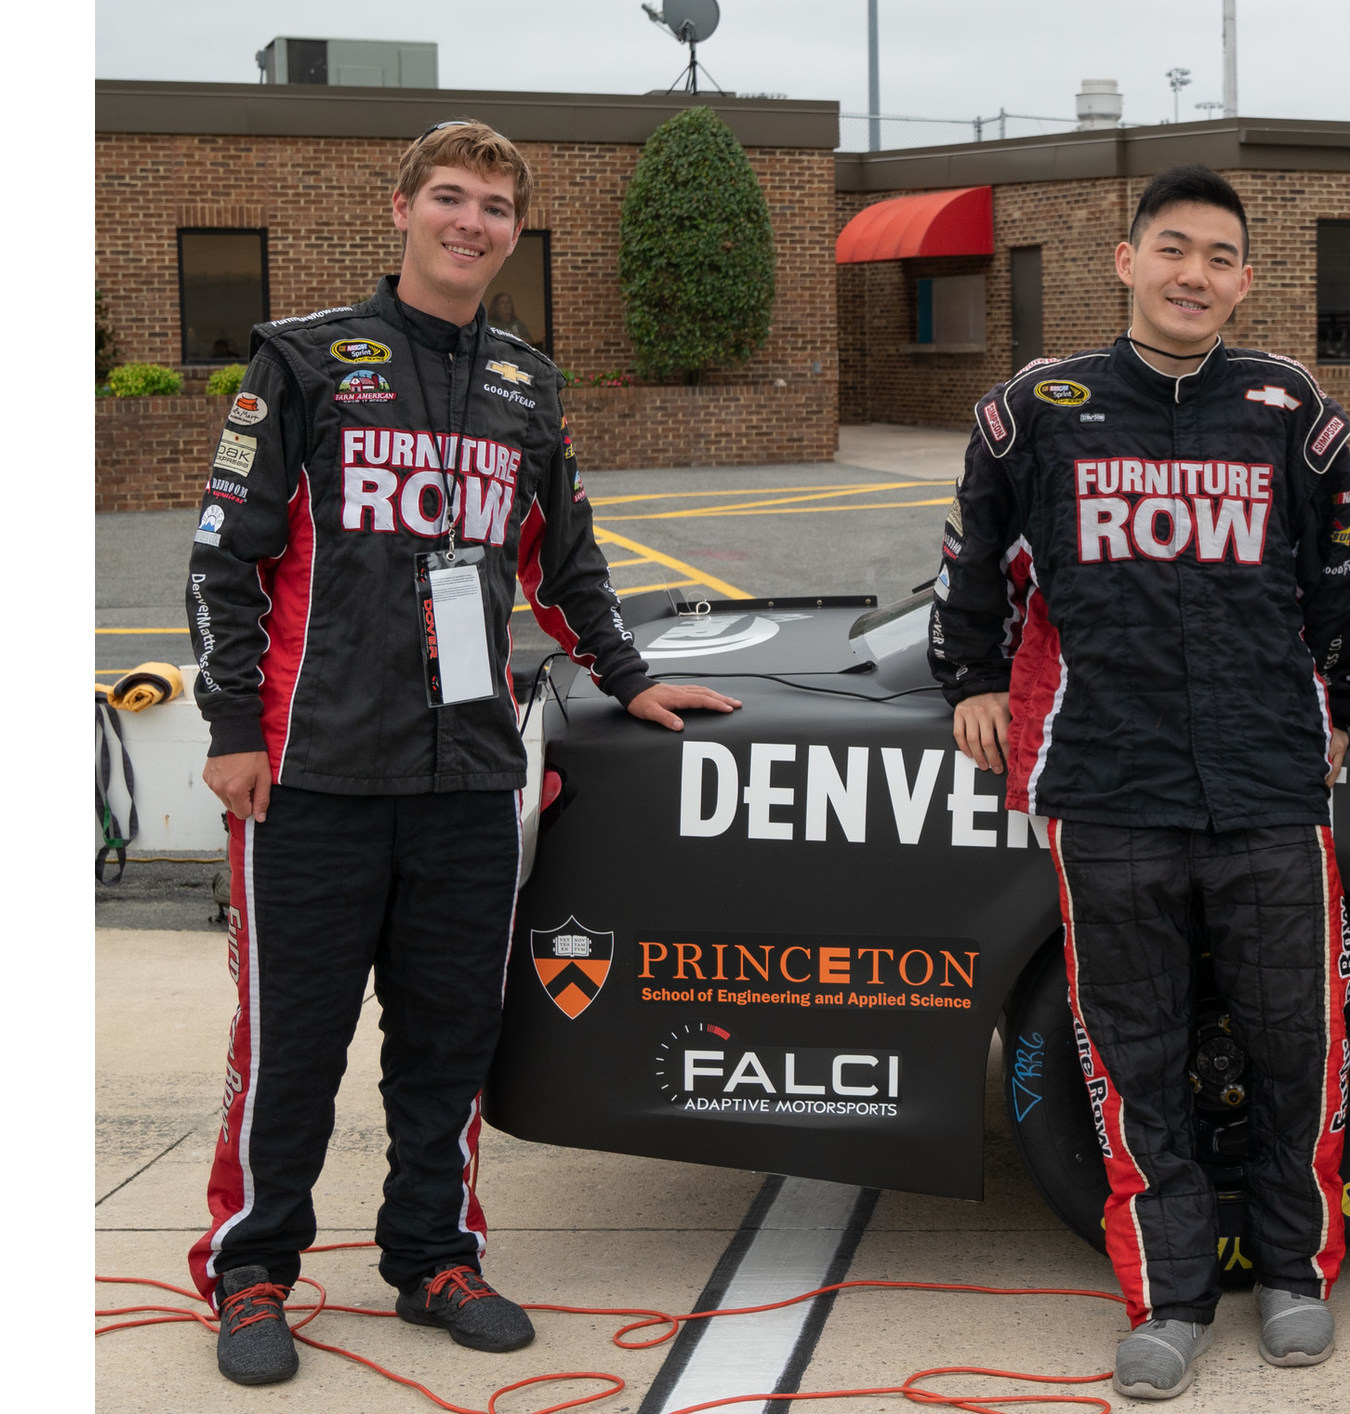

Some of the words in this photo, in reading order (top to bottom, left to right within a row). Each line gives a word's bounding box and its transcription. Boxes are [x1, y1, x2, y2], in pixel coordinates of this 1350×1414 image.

[985, 404, 1004, 438] SIMPSON
[1314, 419, 1342, 453] SIMPSON
[217, 456, 249, 469] XPRESS
[343, 429, 521, 484] FURNITURE
[1077, 460, 1272, 499] FURNITURE
[343, 467, 514, 545] ROW
[1078, 497, 1269, 562] ROW
[424, 599, 438, 660] DOVER
[637, 941, 980, 988] PRINCETON
[641, 987, 694, 1001] School
[697, 988, 713, 1001] of
[717, 989, 811, 1006] Engineering
[815, 992, 843, 1005] and
[848, 992, 906, 1008] Applied
[910, 993, 972, 1008] Science
[684, 1050, 899, 1097] FALCI
[684, 1098, 770, 1112] ADAPTIVE
[775, 1100, 898, 1116] MOTORSPORTS
